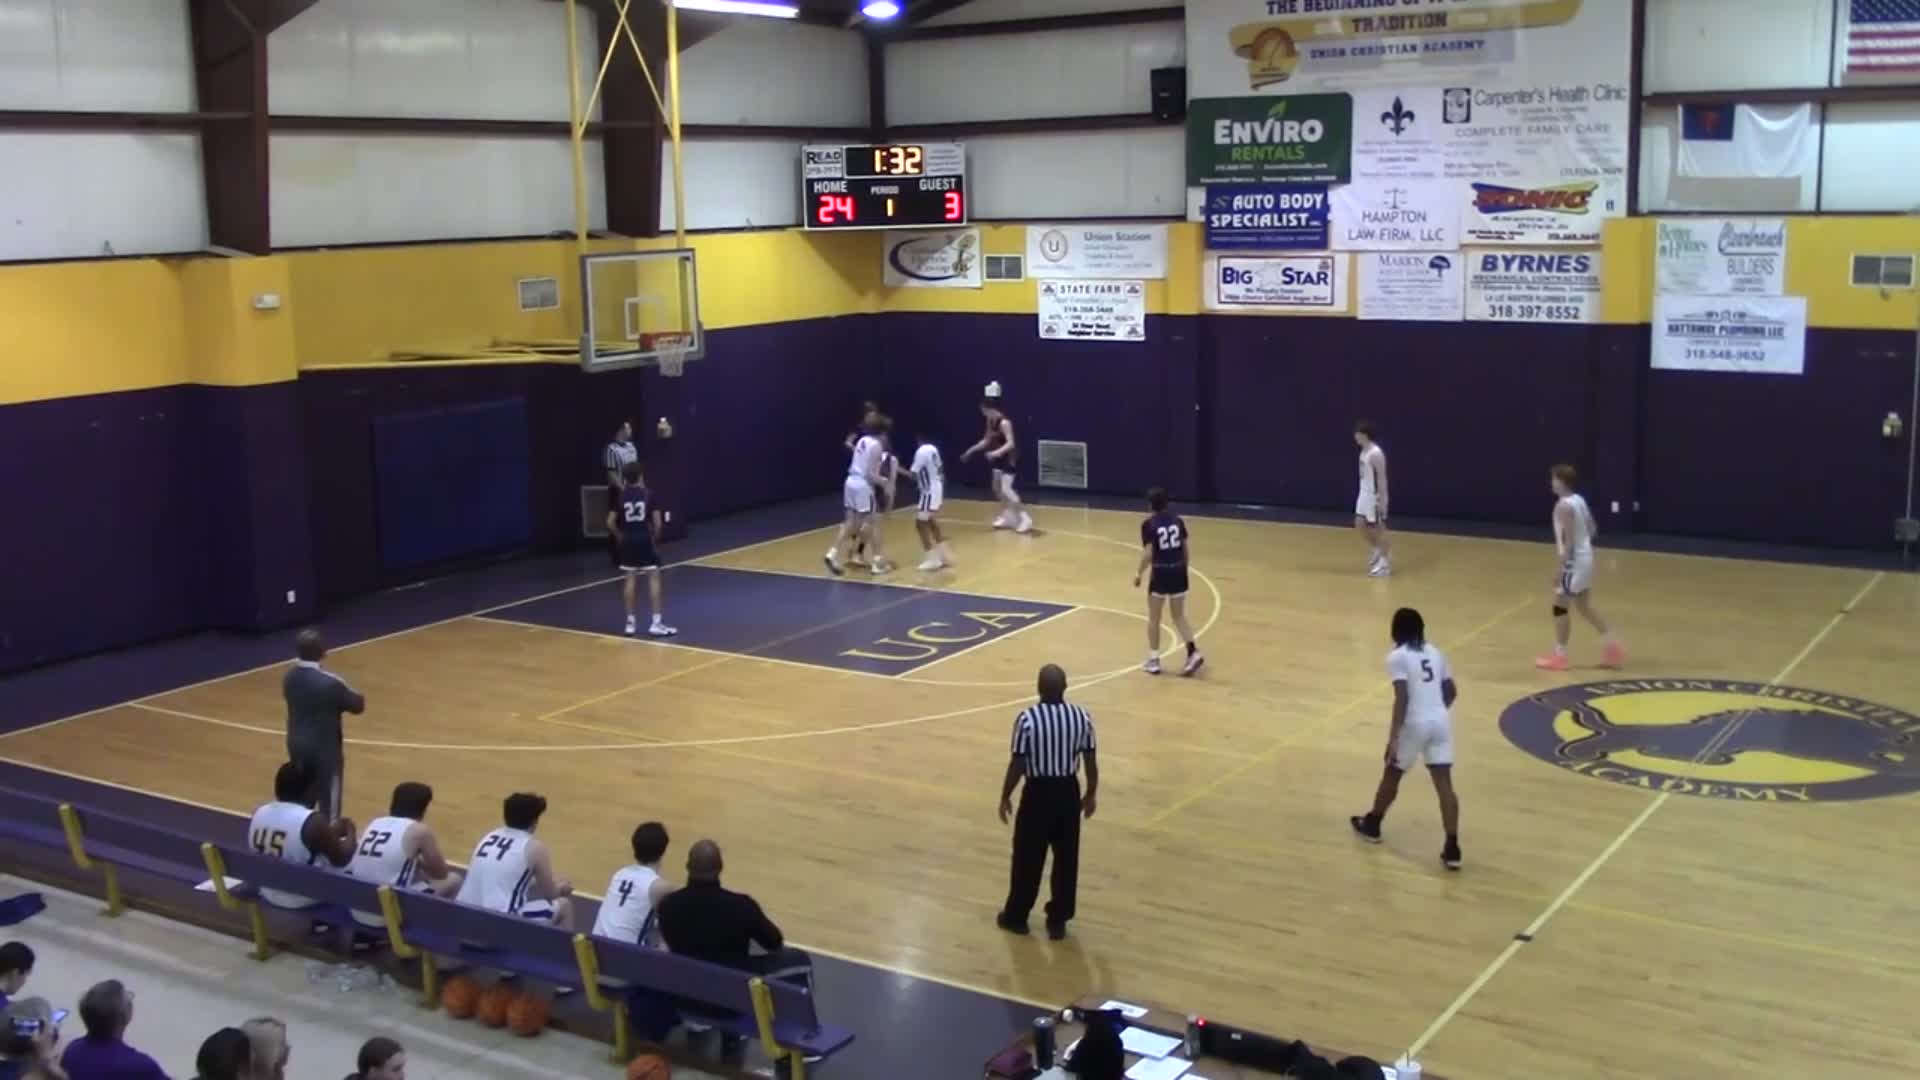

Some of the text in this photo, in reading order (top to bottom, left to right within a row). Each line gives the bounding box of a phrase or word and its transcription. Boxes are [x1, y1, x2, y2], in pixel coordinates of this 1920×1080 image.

[1266, 0, 1297, 14] THE
[1352, 12, 1447, 33] TRADITION
[1351, 44, 1418, 57] CHRISTIAN
[1423, 40, 1485, 52] ACADEMY
[1549, 86, 1590, 101] Health
[1214, 117, 1324, 144] ENVIRO
[1456, 126, 1521, 137] COMPLETE
[874, 147, 921, 174] 1:32
[1231, 146, 1305, 161] RENTALS
[813, 181, 848, 193] HOME
[870, 186, 899, 195] PERIOD
[919, 179, 956, 191] GUEST
[818, 195, 854, 223] 24
[886, 198, 894, 217] 1
[944, 191, 961, 219] 3
[1233, 193, 1324, 210] AUTO BODY
[1211, 213, 1309, 227] SPECIALIST
[1361, 210, 1427, 223] HAMPTON
[1084, 232, 1152, 242] Union Station
[1348, 228, 1376, 241] LAW
[1420, 228, 1445, 241] LLC
[1481, 254, 1590, 273] BYRNES
[1060, 285, 1121, 294] STATE FARM
[623, 501, 646, 522] 23
[1157, 525, 1180, 549] 22
[837, 611, 1042, 661] UCA
[1421, 660, 1434, 682] 5
[252, 828, 287, 858] 45
[359, 830, 391, 858] 22
[476, 834, 514, 861] 24
[619, 879, 633, 907] 4
